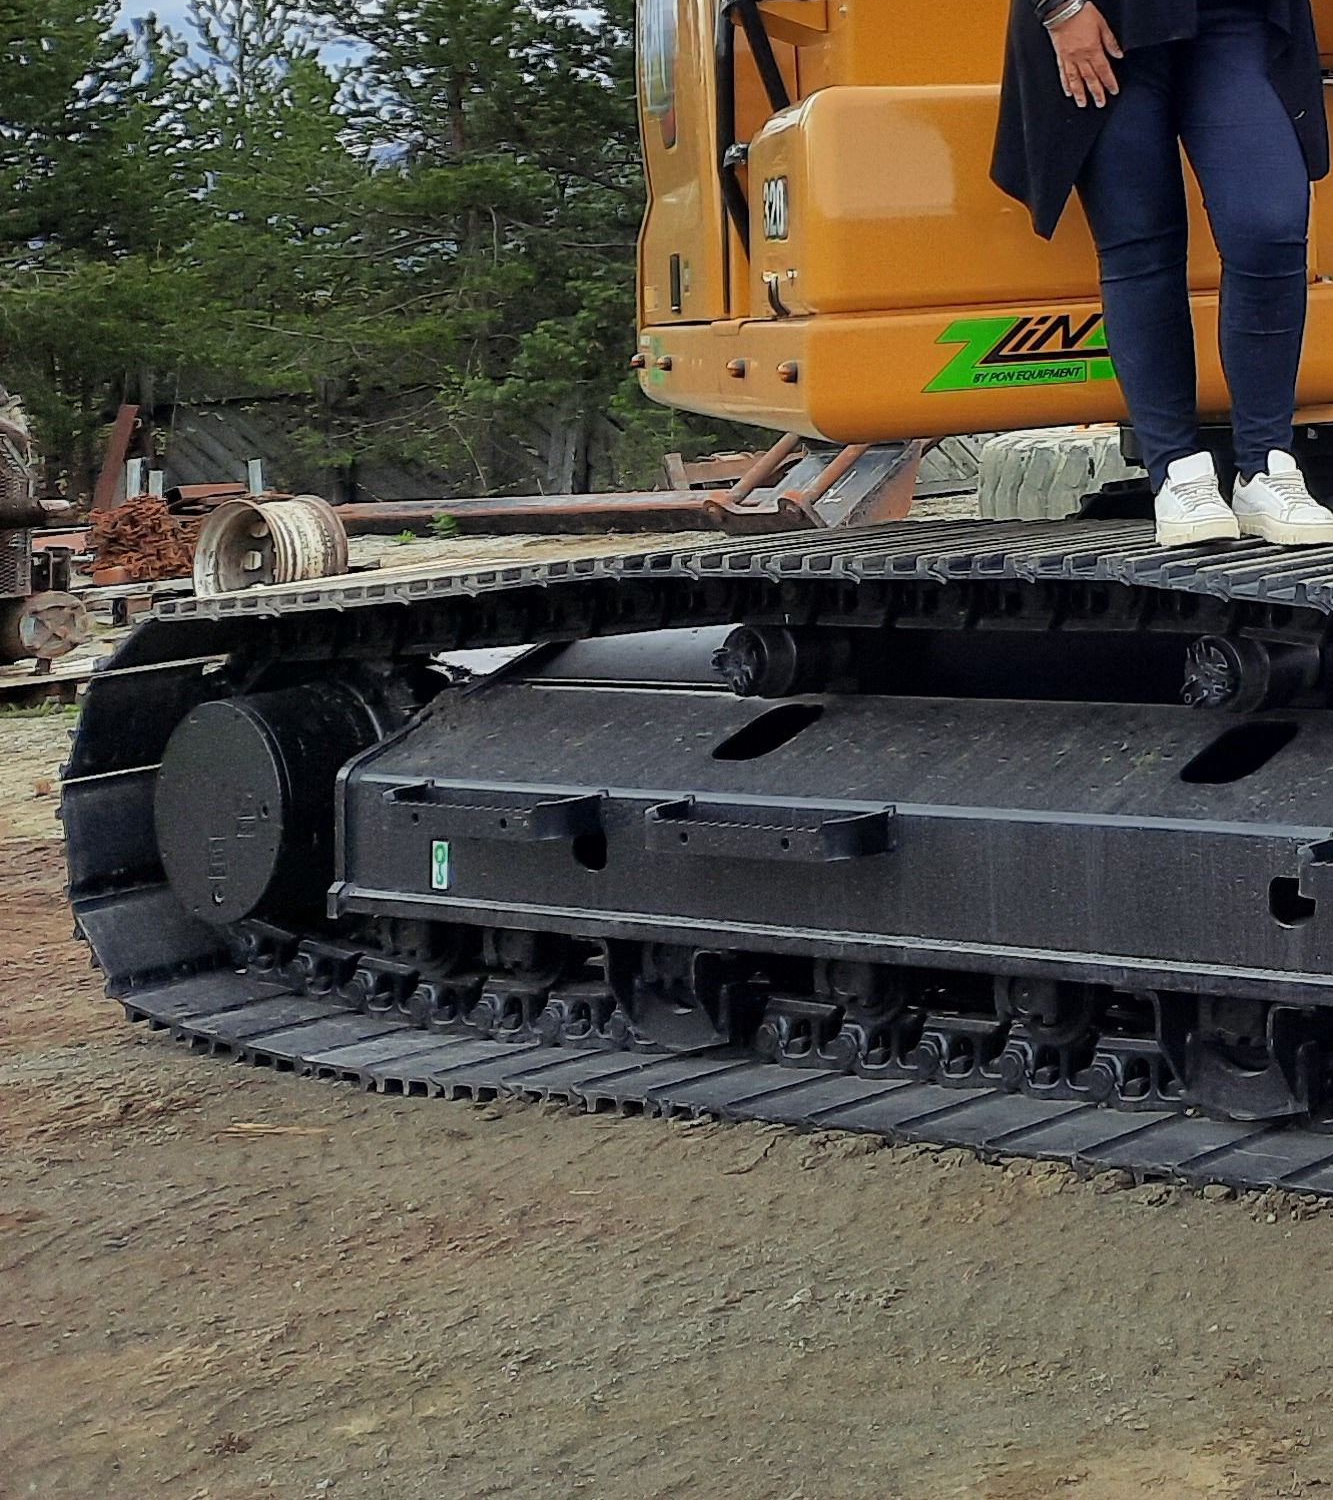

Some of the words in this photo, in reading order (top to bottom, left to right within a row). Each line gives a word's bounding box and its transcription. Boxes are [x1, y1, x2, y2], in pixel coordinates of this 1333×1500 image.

[763, 179, 784, 237] 320
[973, 372, 988, 384] BY
[990, 371, 1016, 382] PON
[1017, 366, 1083, 381] EQUIPMENT
